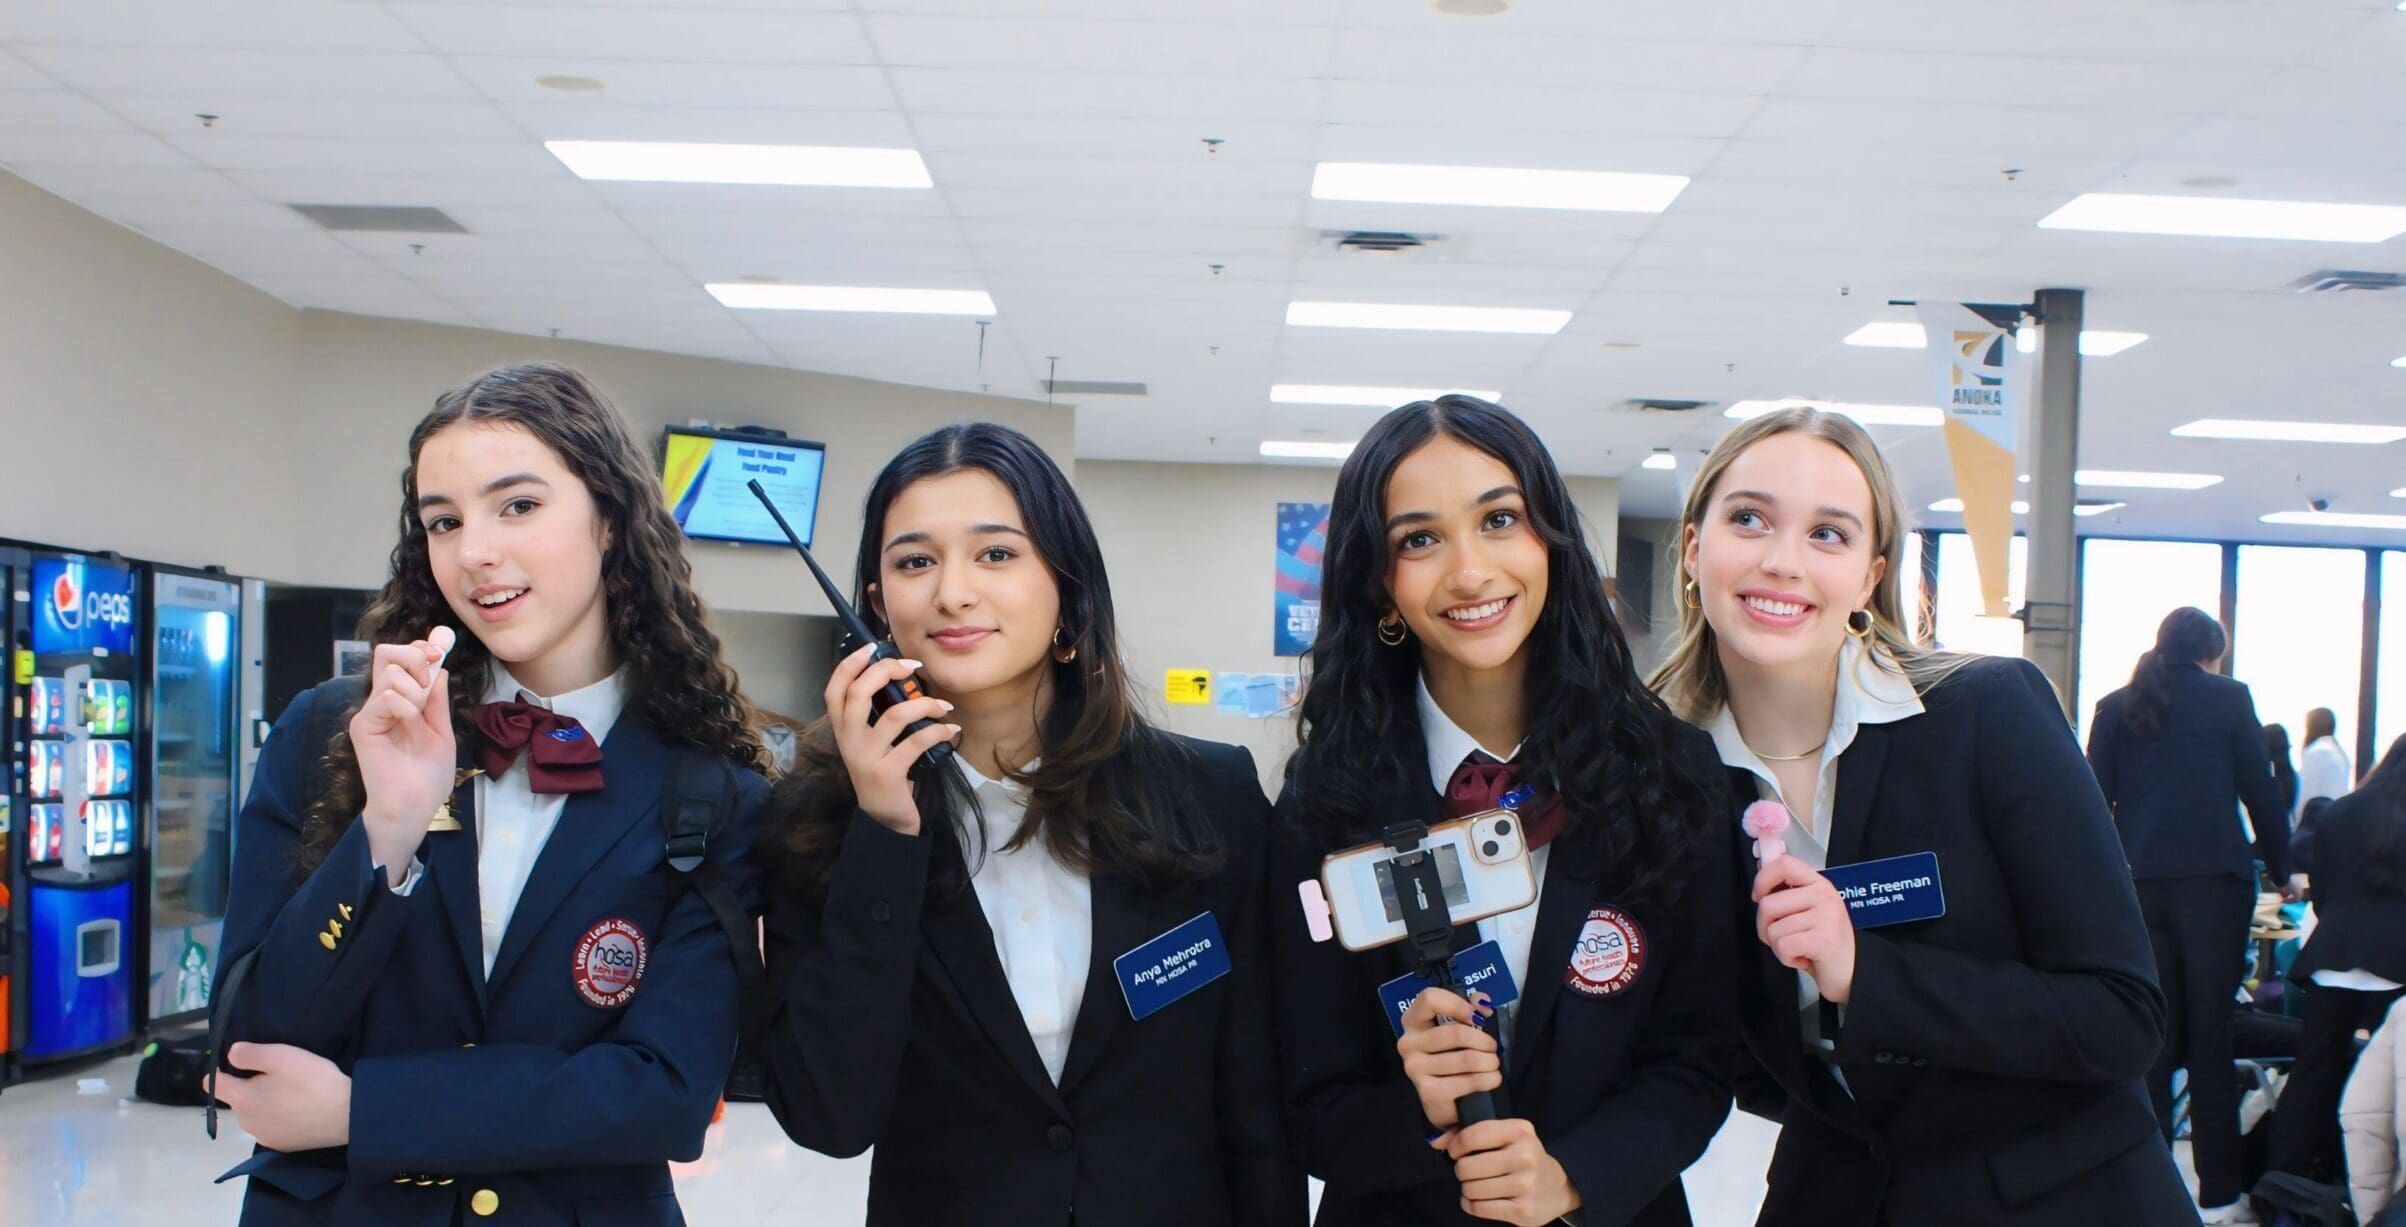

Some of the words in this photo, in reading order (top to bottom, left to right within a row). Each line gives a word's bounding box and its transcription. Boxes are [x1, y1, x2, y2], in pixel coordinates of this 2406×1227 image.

[1952, 388, 2002, 405] ANOKA
[86, 591, 131, 631] peps
[1870, 876, 1931, 895] Freeman
[1851, 899, 1864, 909] MN
[1866, 896, 1891, 907] HOSA
[1892, 893, 1904, 903] PR
[1588, 909, 1611, 919] erve
[576, 943, 590, 970] Learn
[589, 921, 611, 940] Lead
[595, 941, 634, 968] hosa
[1134, 964, 1161, 986] Anya
[1162, 938, 1212, 970] Mehrotra
[1155, 975, 1168, 987] MN
[1168, 965, 1188, 981] HOSA
[1188, 959, 1198, 969] PR
[1464, 963, 1497, 986] asuri
[1570, 976, 1610, 994] Founded
[1610, 981, 1621, 991] in
